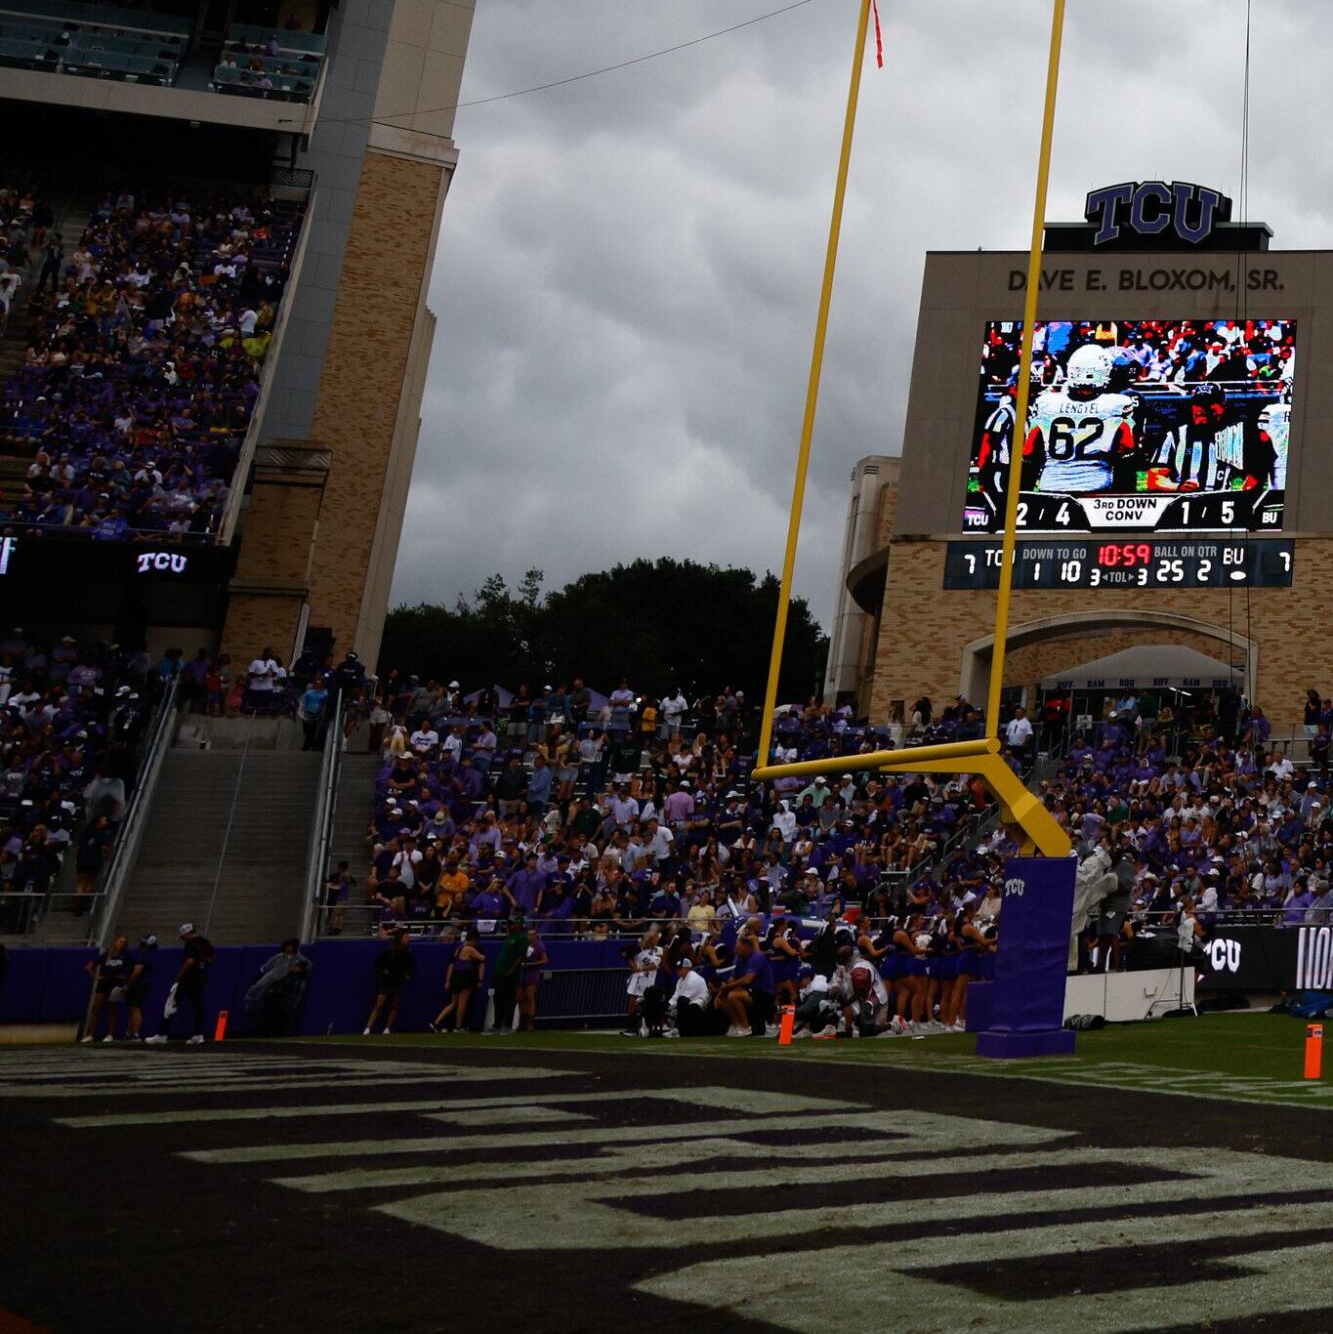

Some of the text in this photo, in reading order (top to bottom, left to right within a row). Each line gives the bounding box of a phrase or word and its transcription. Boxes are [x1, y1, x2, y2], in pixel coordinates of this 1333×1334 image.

[1087, 181, 1220, 245] TCU
[1008, 269, 1284, 292] DVE E. BLOXOM, SR.
[1050, 416, 1105, 460] 62
[1093, 498, 1157, 510] 3RD DOWN
[1182, 502, 1190, 525] 1
[1221, 501, 1234, 524] 5
[967, 513, 989, 526] TCU
[1015, 502, 1027, 526] 2
[1056, 502, 1070, 526] 4
[1105, 510, 1143, 522] CONV
[1262, 512, 1278, 524] BU
[985, 549, 1016, 567] TC
[1023, 547, 1087, 560] DOWN TO GO
[1097, 544, 1150, 566] 10:59
[1154, 546, 1195, 559] BALL ON
[1198, 546, 1217, 558] QTR
[1223, 548, 1244, 565] BU
[137, 551, 188, 574] TCU
[964, 554, 976, 575] 7
[1033, 562, 1040, 581] 1
[1156, 560, 1184, 582] 25
[1197, 560, 1212, 582] 2
[1279, 552, 1290, 572] 7
[1061, 561, 1081, 583] 10
[1090, 568, 1100, 587] 3
[1109, 572, 1128, 584] TOL
[1137, 567, 1148, 586] 3
[1087, 679, 1105, 688] RAM
[1183, 678, 1200, 687] RAM
[1005, 878, 1025, 897] TCU
